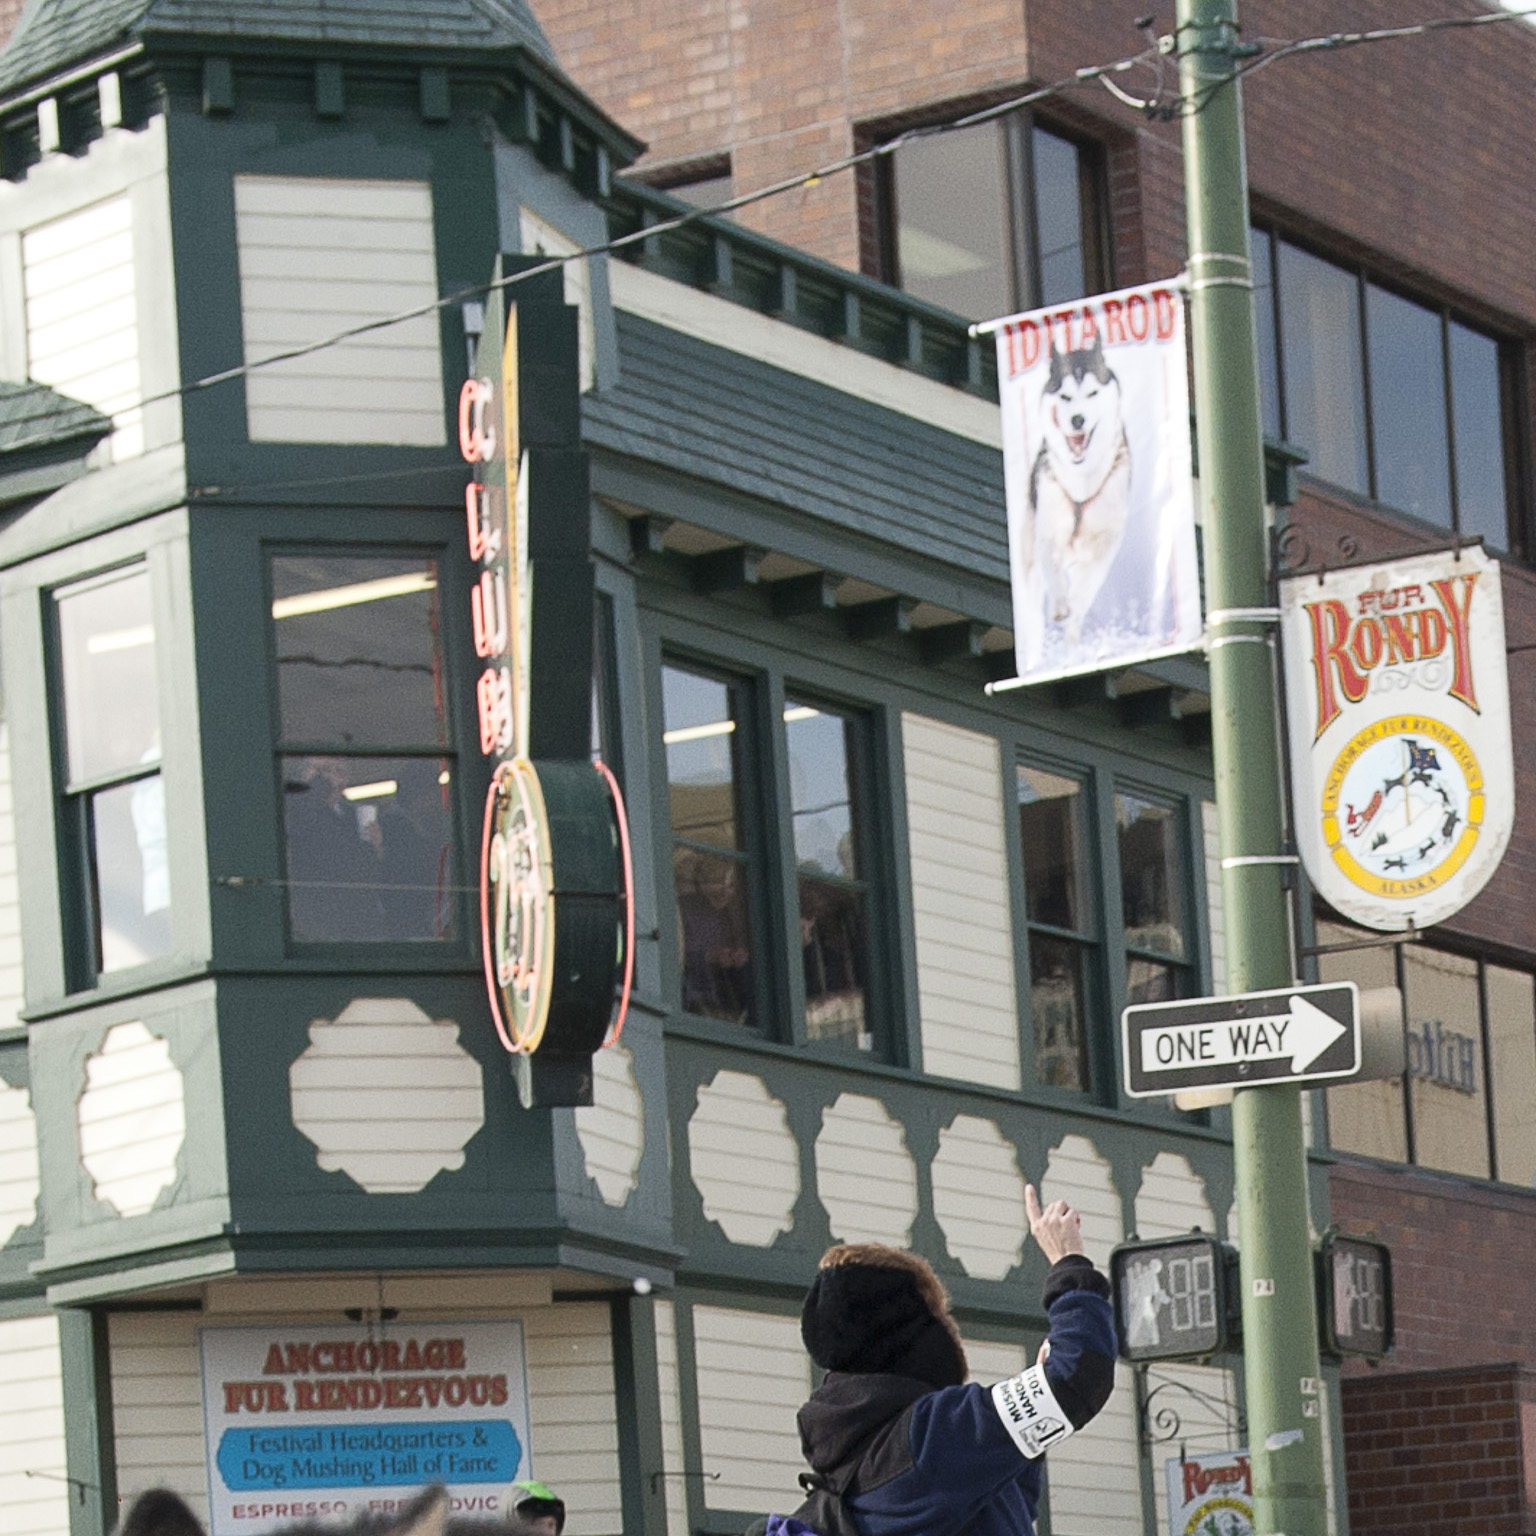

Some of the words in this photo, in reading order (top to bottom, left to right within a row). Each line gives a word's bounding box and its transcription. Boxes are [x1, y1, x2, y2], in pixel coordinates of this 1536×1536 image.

[1004, 288, 1175, 378] IDITAROD
[1357, 584, 1425, 615] FUR
[1157, 1027, 1214, 1064] ONE
[1228, 1019, 1290, 1055] WAY
[262, 1337, 467, 1375] ANCHORAGE
[223, 1381, 289, 1413] FUR
[294, 1374, 510, 1410] RENDEZVOUS
[249, 1431, 323, 1454] Festival
[330, 1428, 465, 1453] Headquarters
[471, 1427, 489, 1446] &
[243, 1459, 287, 1485] Dog
[291, 1454, 374, 1482] Mushing
[381, 1450, 417, 1476] Hall
[423, 1452, 443, 1474] of
[448, 1451, 498, 1473] Fame
[233, 1501, 347, 1519] ESPRESSO
